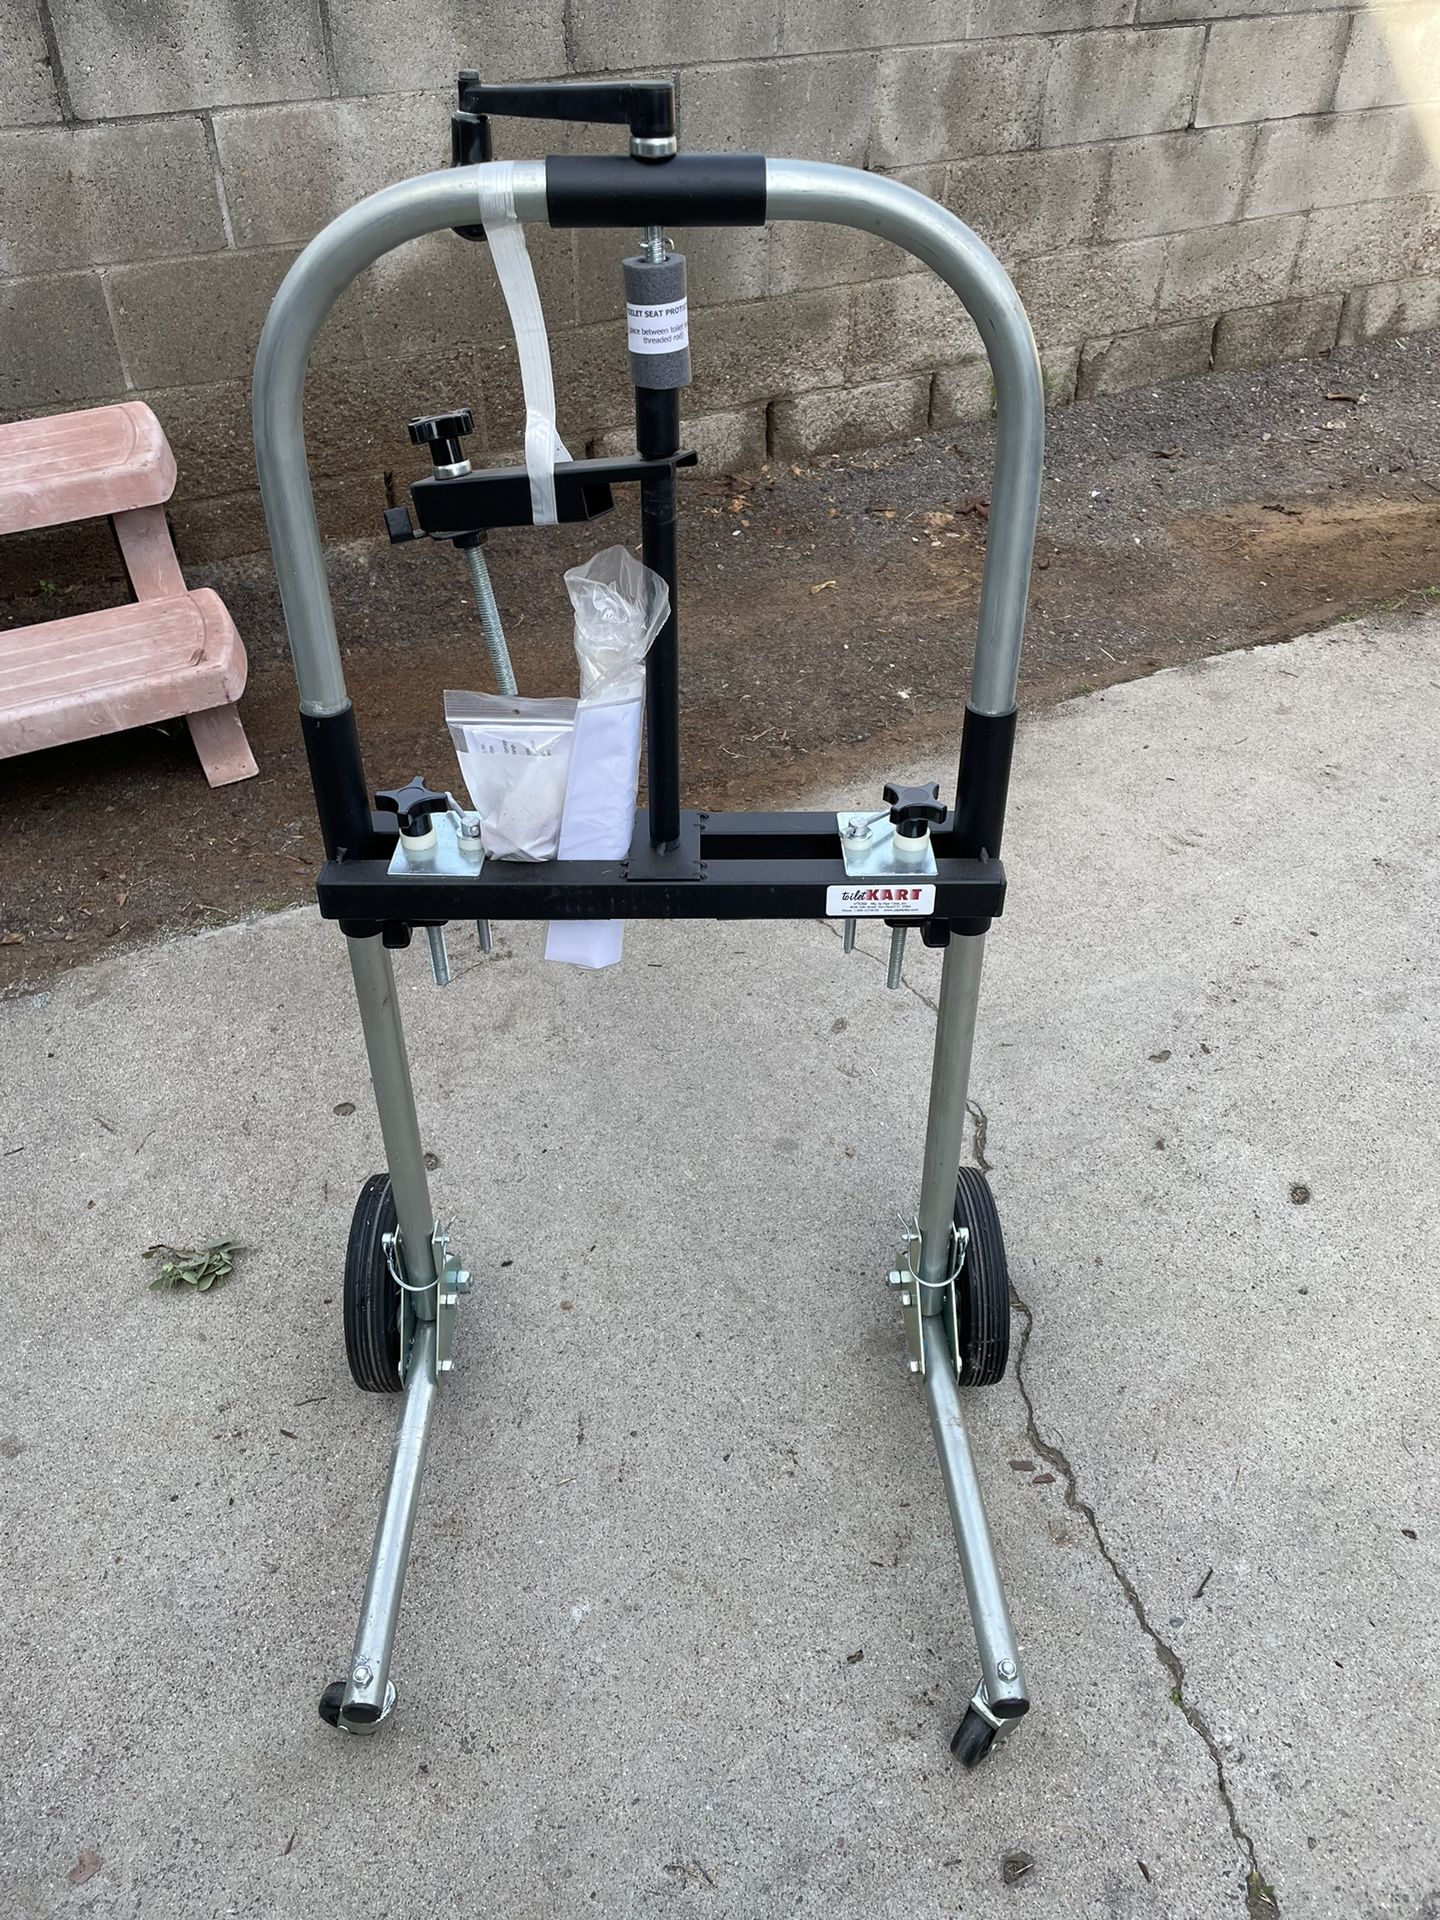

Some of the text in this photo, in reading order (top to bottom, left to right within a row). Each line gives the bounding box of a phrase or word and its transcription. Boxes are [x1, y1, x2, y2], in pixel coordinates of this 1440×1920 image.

[644, 310, 663, 318] SEAT
[641, 327, 669, 336] between
[643, 335, 672, 344] threaded
